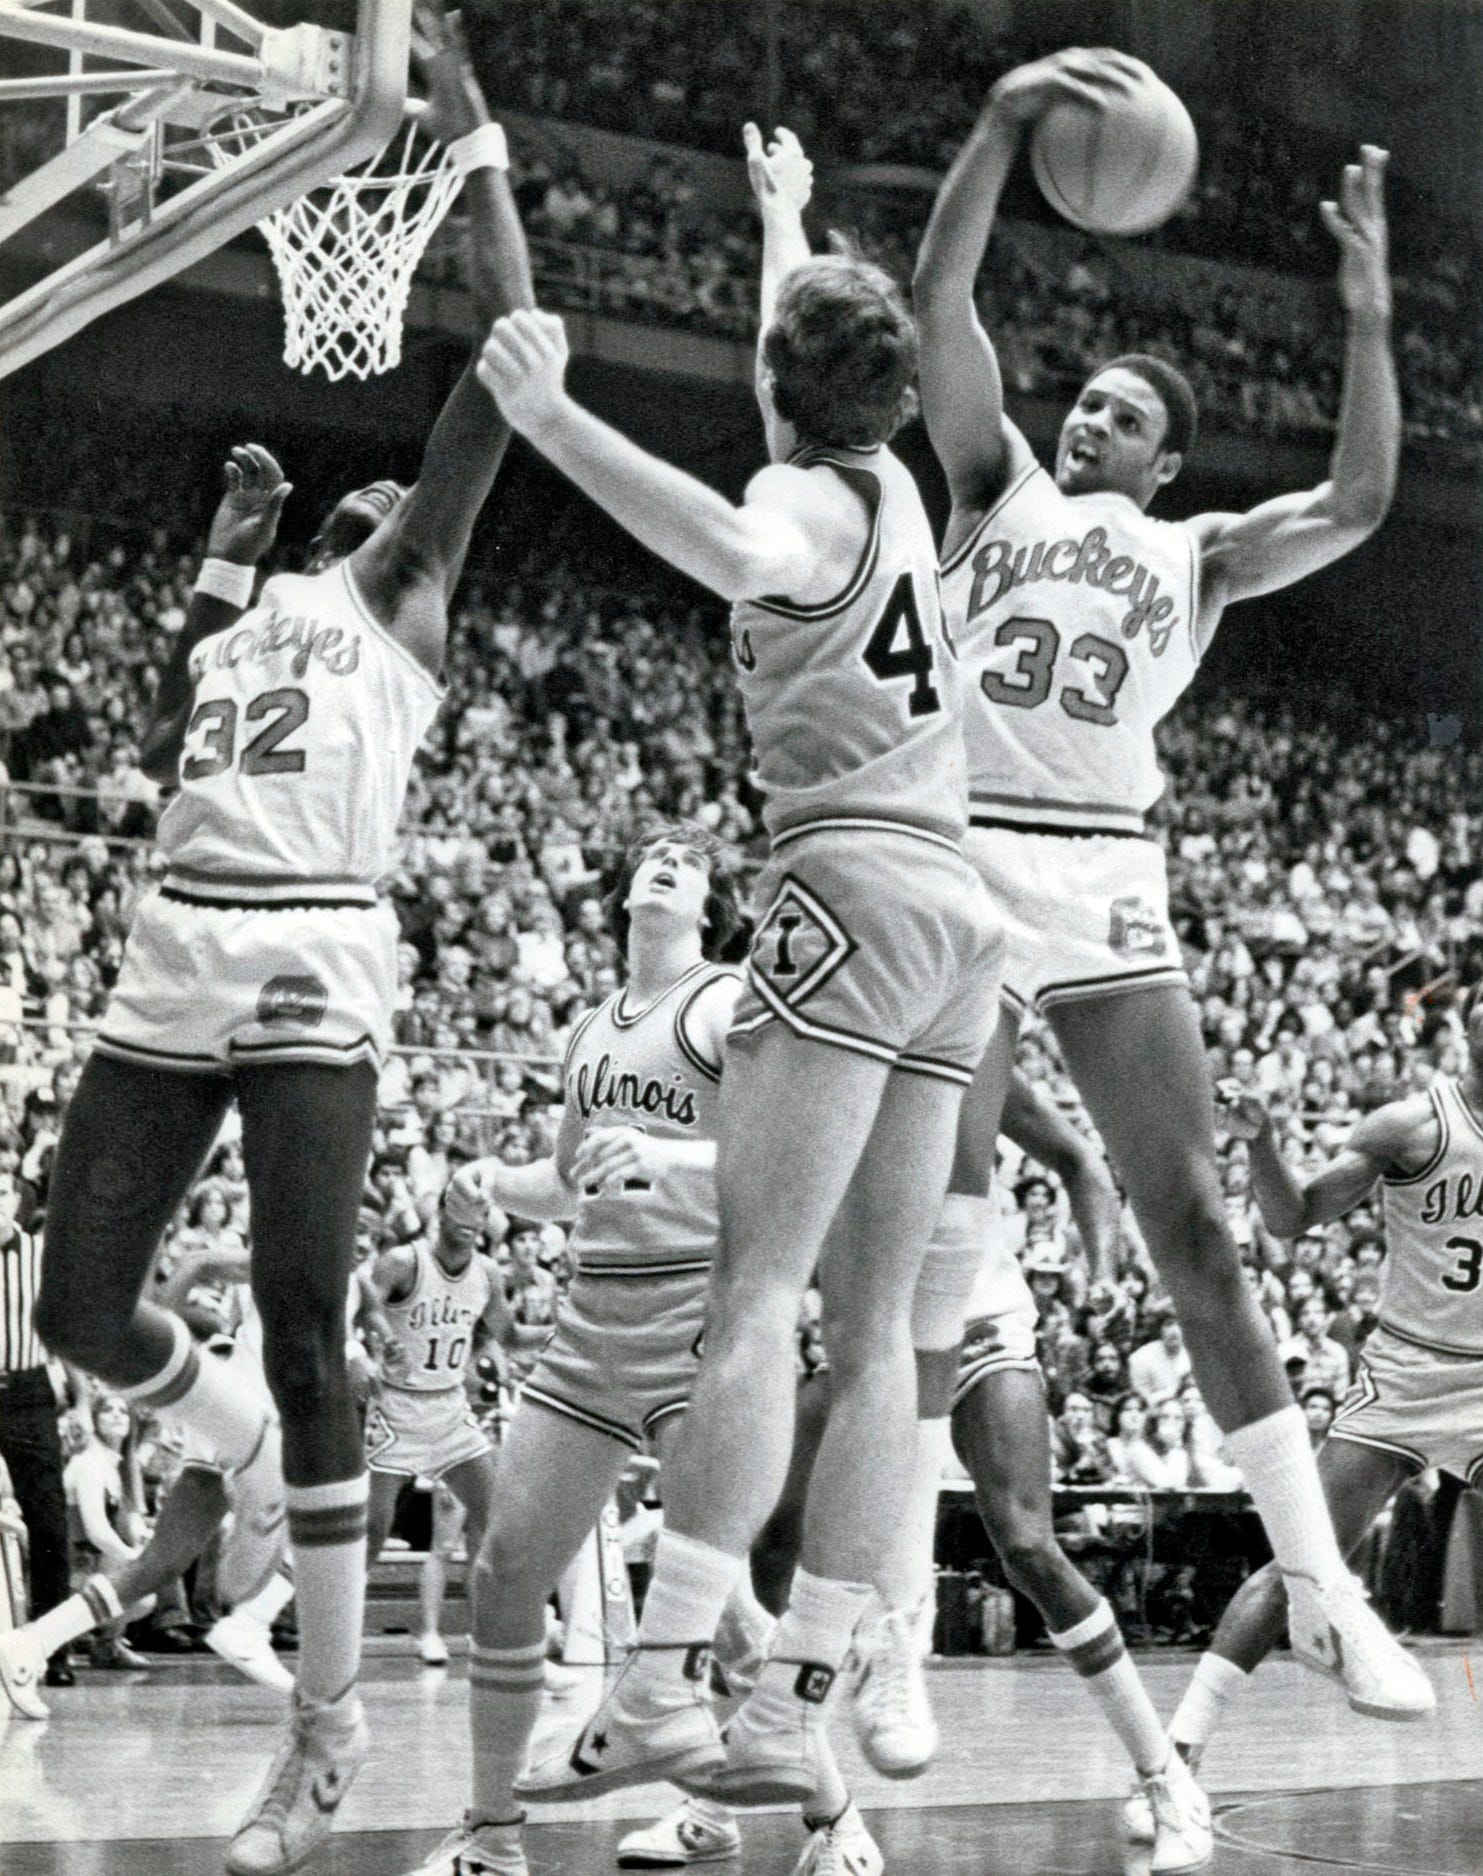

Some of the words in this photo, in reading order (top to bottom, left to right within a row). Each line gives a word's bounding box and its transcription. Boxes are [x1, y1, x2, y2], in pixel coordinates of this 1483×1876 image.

[862, 571, 942, 718] 4
[966, 526, 1180, 658] Buckeyes
[980, 615, 1129, 727] 33
[182, 686, 310, 781] 32
[424, 1338, 466, 1370] 10
